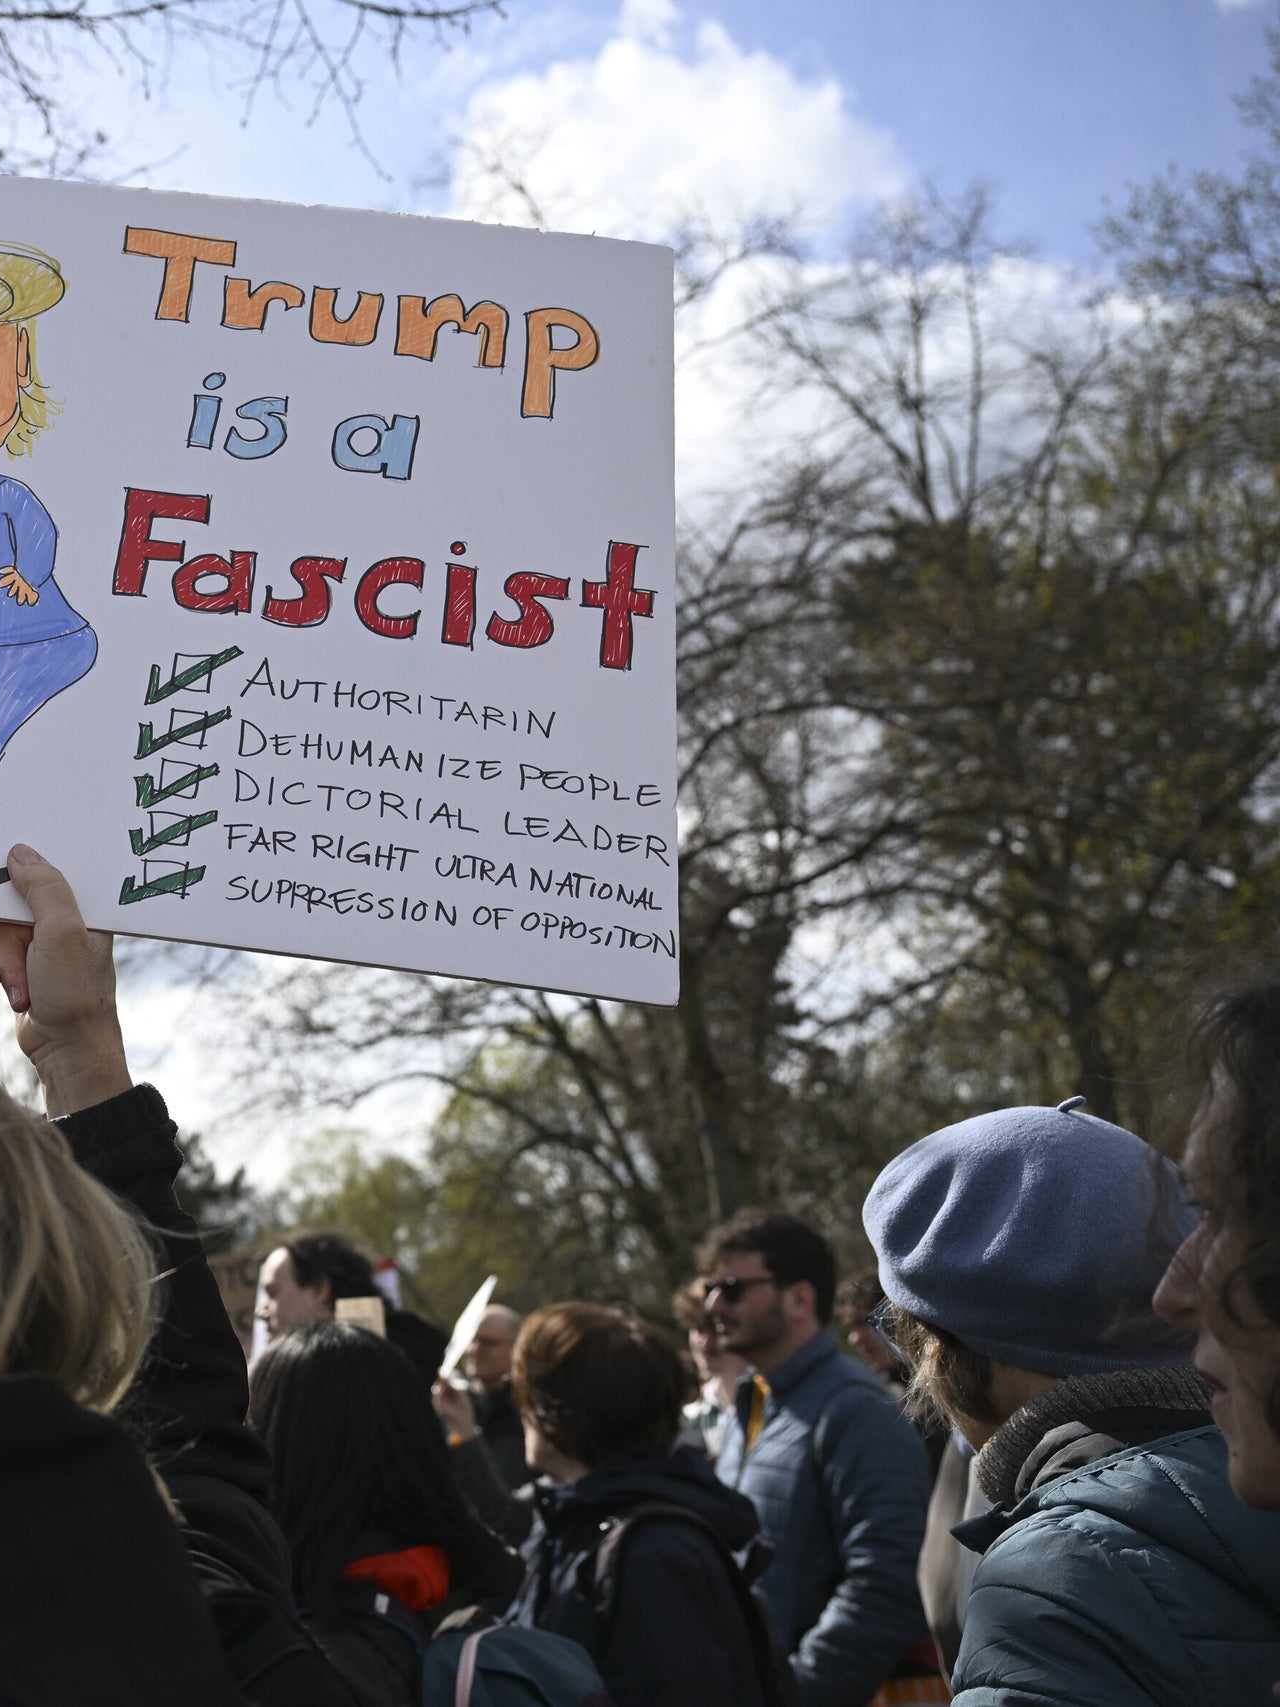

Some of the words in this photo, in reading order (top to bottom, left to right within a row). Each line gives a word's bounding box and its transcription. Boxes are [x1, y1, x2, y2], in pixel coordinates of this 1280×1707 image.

[123, 225, 601, 420] Trump
[186, 372, 289, 459] is
[332, 414, 420, 480] a
[112, 487, 658, 670] Fascist
[240, 657, 556, 738] AUTHORITARIN
[235, 768, 479, 833] DICTORIAL
[504, 811, 669, 866] LEADER
[520, 764, 662, 806] PEOPLE
[223, 824, 297, 855] FAR
[311, 834, 420, 872] RIGHT
[435, 855, 517, 887] ULTRA
[530, 867, 662, 910] NATIONAL
[472, 905, 514, 929] OF
[520, 911, 676, 958] OPPOSITION
